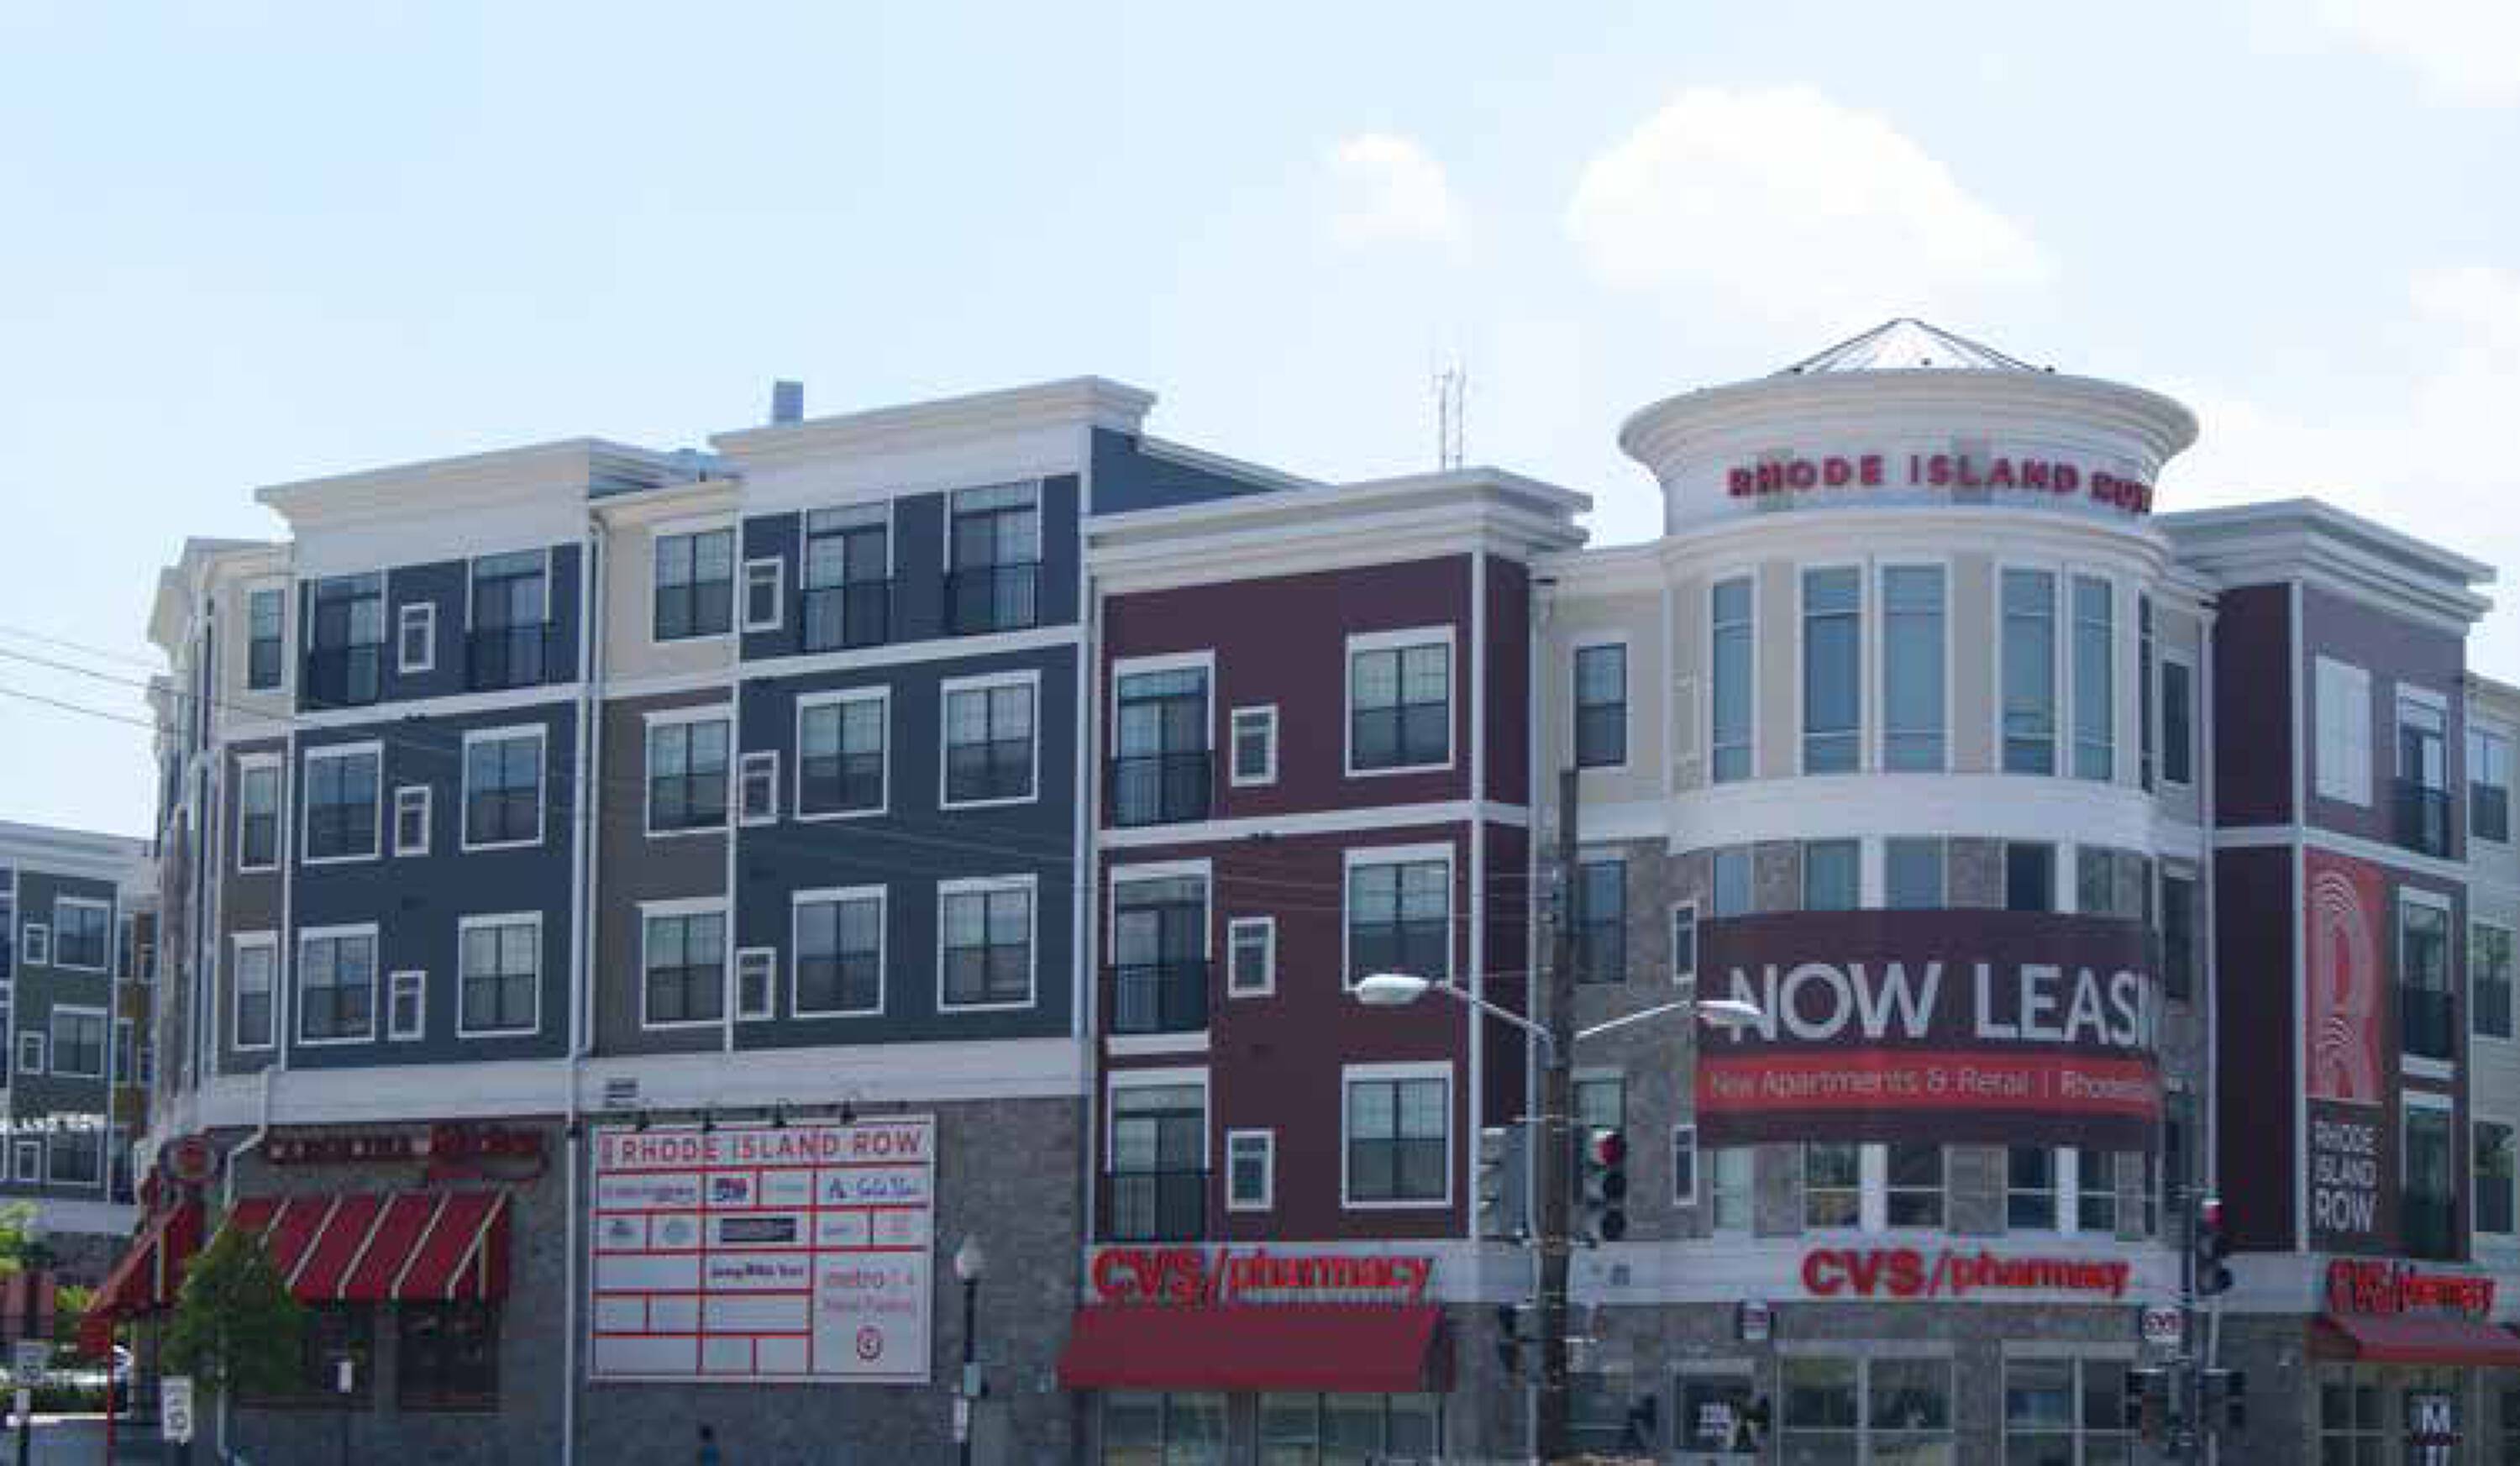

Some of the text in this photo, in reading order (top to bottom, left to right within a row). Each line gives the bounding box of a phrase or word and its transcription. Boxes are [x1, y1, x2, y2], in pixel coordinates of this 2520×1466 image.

[1728, 455, 1883, 497] RHODE
[1909, 454, 2080, 495] ISLAND
[1728, 962, 1943, 1043] NOW
[621, 1136, 722, 1164] RHODE
[732, 1132, 839, 1161] ISLAND
[851, 1130, 922, 1156] ROW
[2313, 1119, 2375, 1154] RHODE
[2314, 1154, 2377, 1188] ISLAND
[2314, 1188, 2378, 1232] ROW
